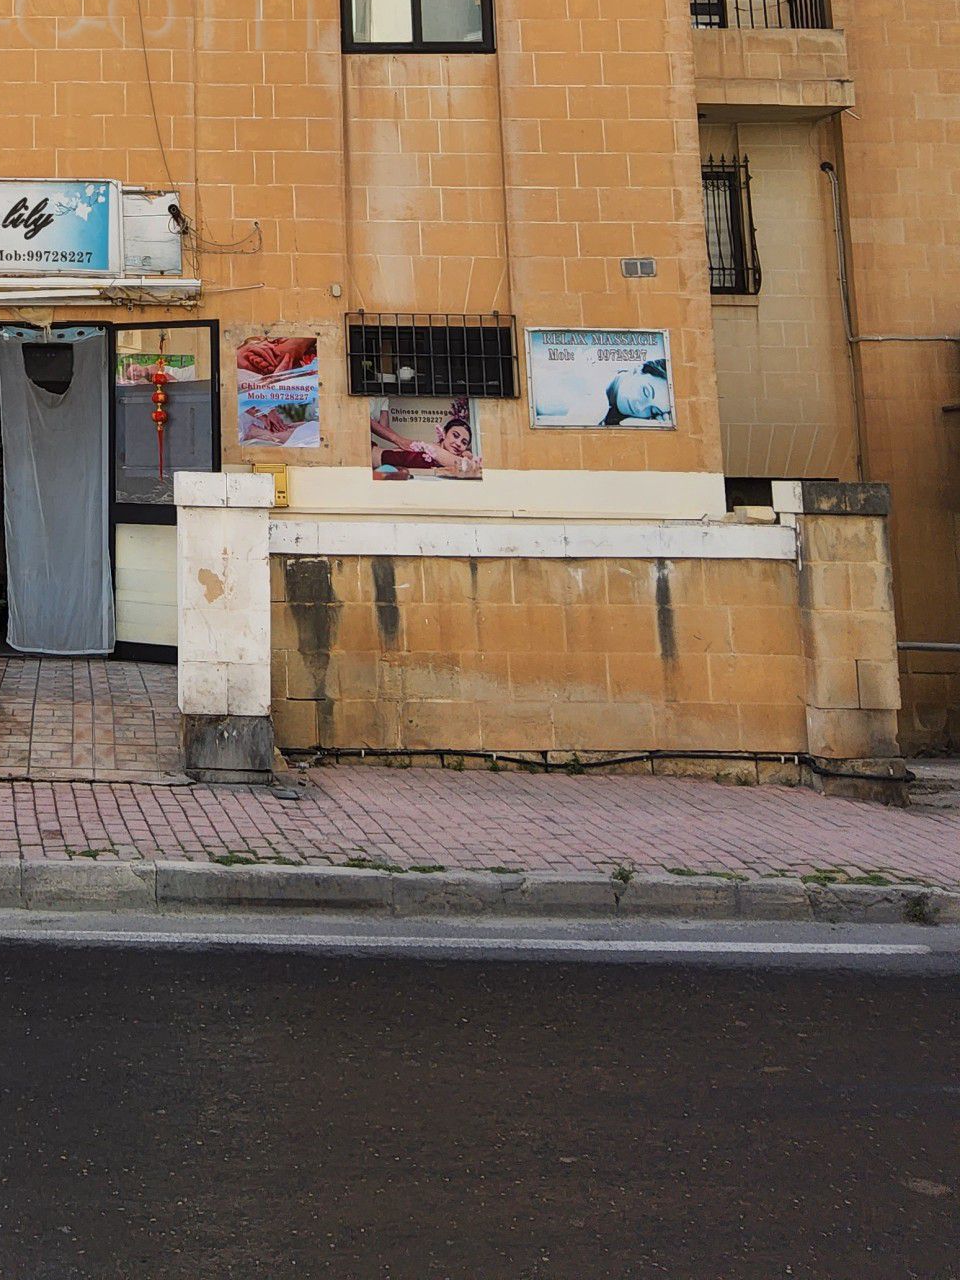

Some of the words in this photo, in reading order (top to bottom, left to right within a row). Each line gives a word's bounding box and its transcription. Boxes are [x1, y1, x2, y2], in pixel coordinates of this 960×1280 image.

[2, 197, 54, 239] lily
[543, 333, 588, 345] RELAX
[591, 334, 658, 345] MASSAGE
[548, 348, 575, 361] Mob:
[241, 382, 276, 390] Chinese
[421, 409, 453, 417] massage
